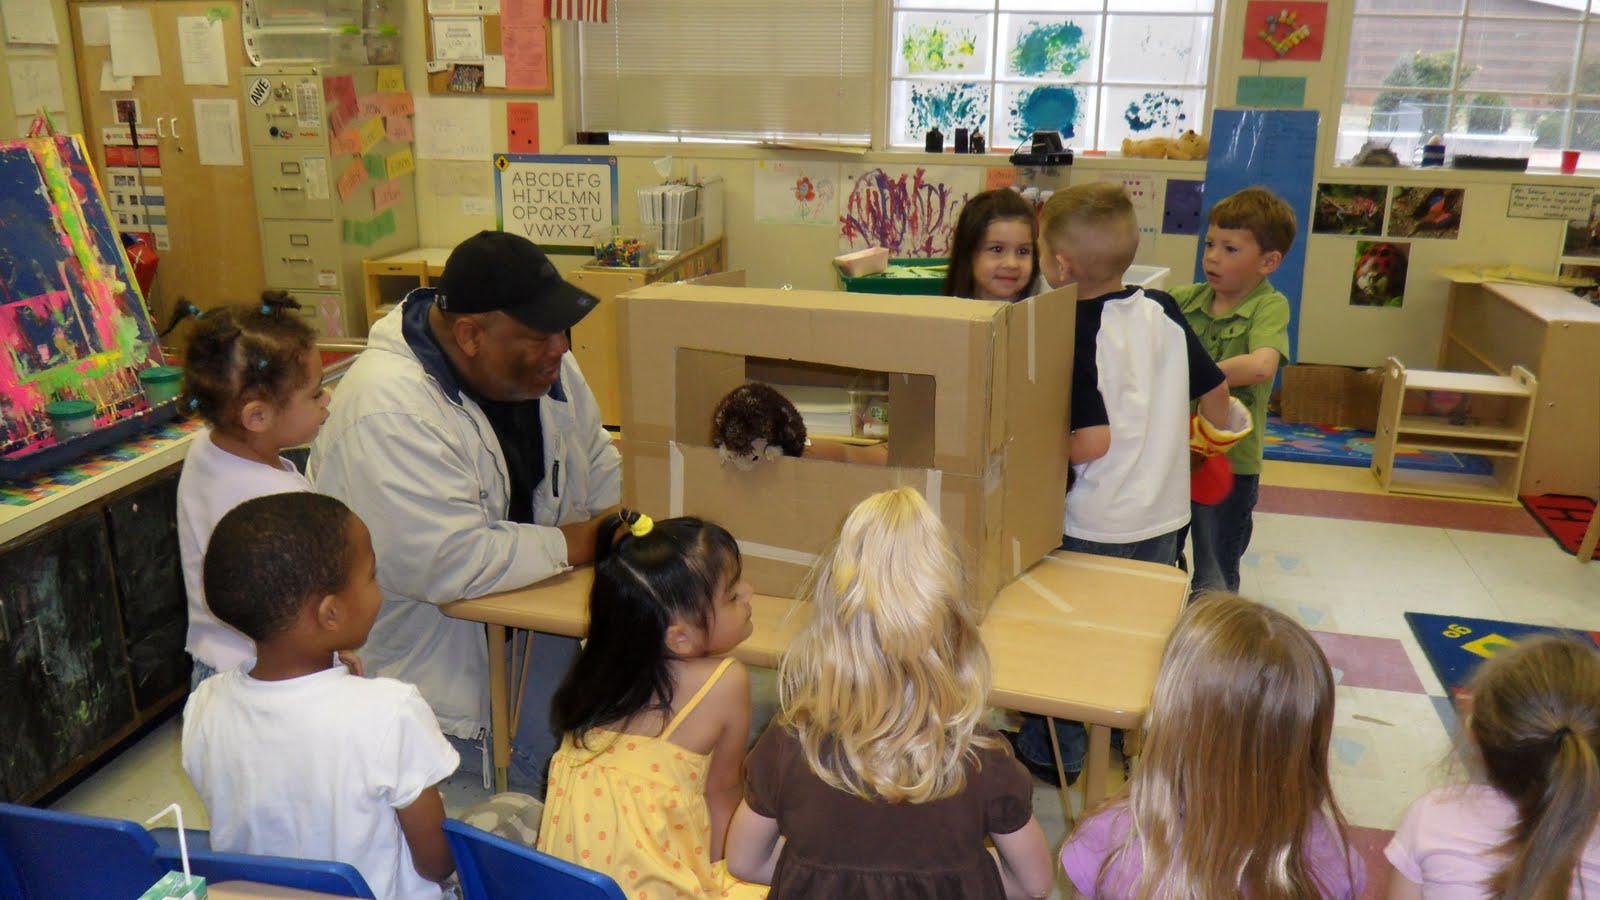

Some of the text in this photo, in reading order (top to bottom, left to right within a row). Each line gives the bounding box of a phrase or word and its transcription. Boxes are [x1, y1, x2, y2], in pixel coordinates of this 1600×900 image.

[250, 78, 270, 105] AWE
[512, 171, 601, 188] ABCDEFG
[512, 189, 600, 205] HIJKLMN
[512, 205, 602, 223] OPQRSTU
[523, 223, 592, 239] VWXYZ
